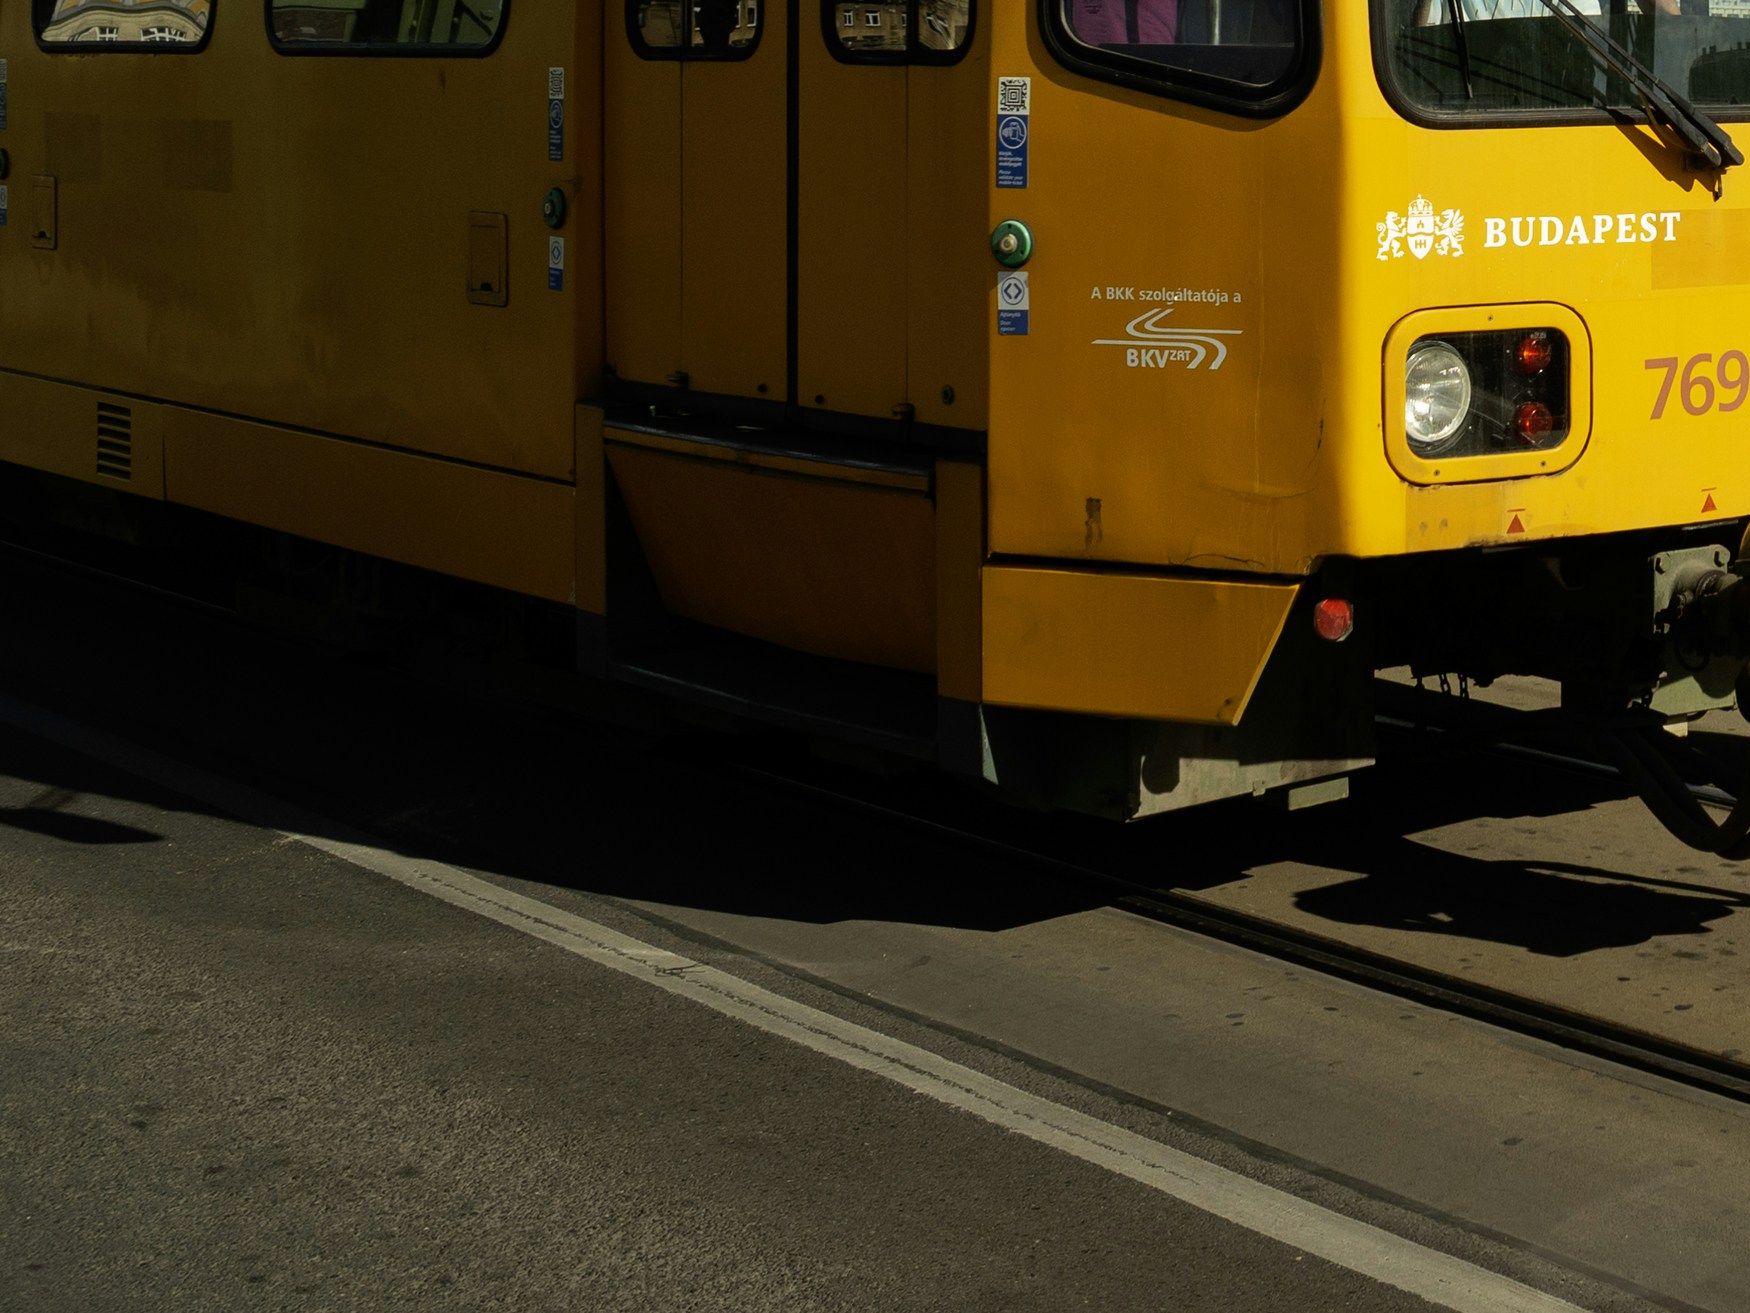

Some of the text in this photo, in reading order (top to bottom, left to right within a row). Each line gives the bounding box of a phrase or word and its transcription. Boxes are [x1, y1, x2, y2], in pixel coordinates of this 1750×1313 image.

[1484, 212, 1681, 248] BUDAPEST
[1091, 287, 1242, 306] A BKK szolgáltatója a
[1126, 348, 1192, 369] BKV ZRT
